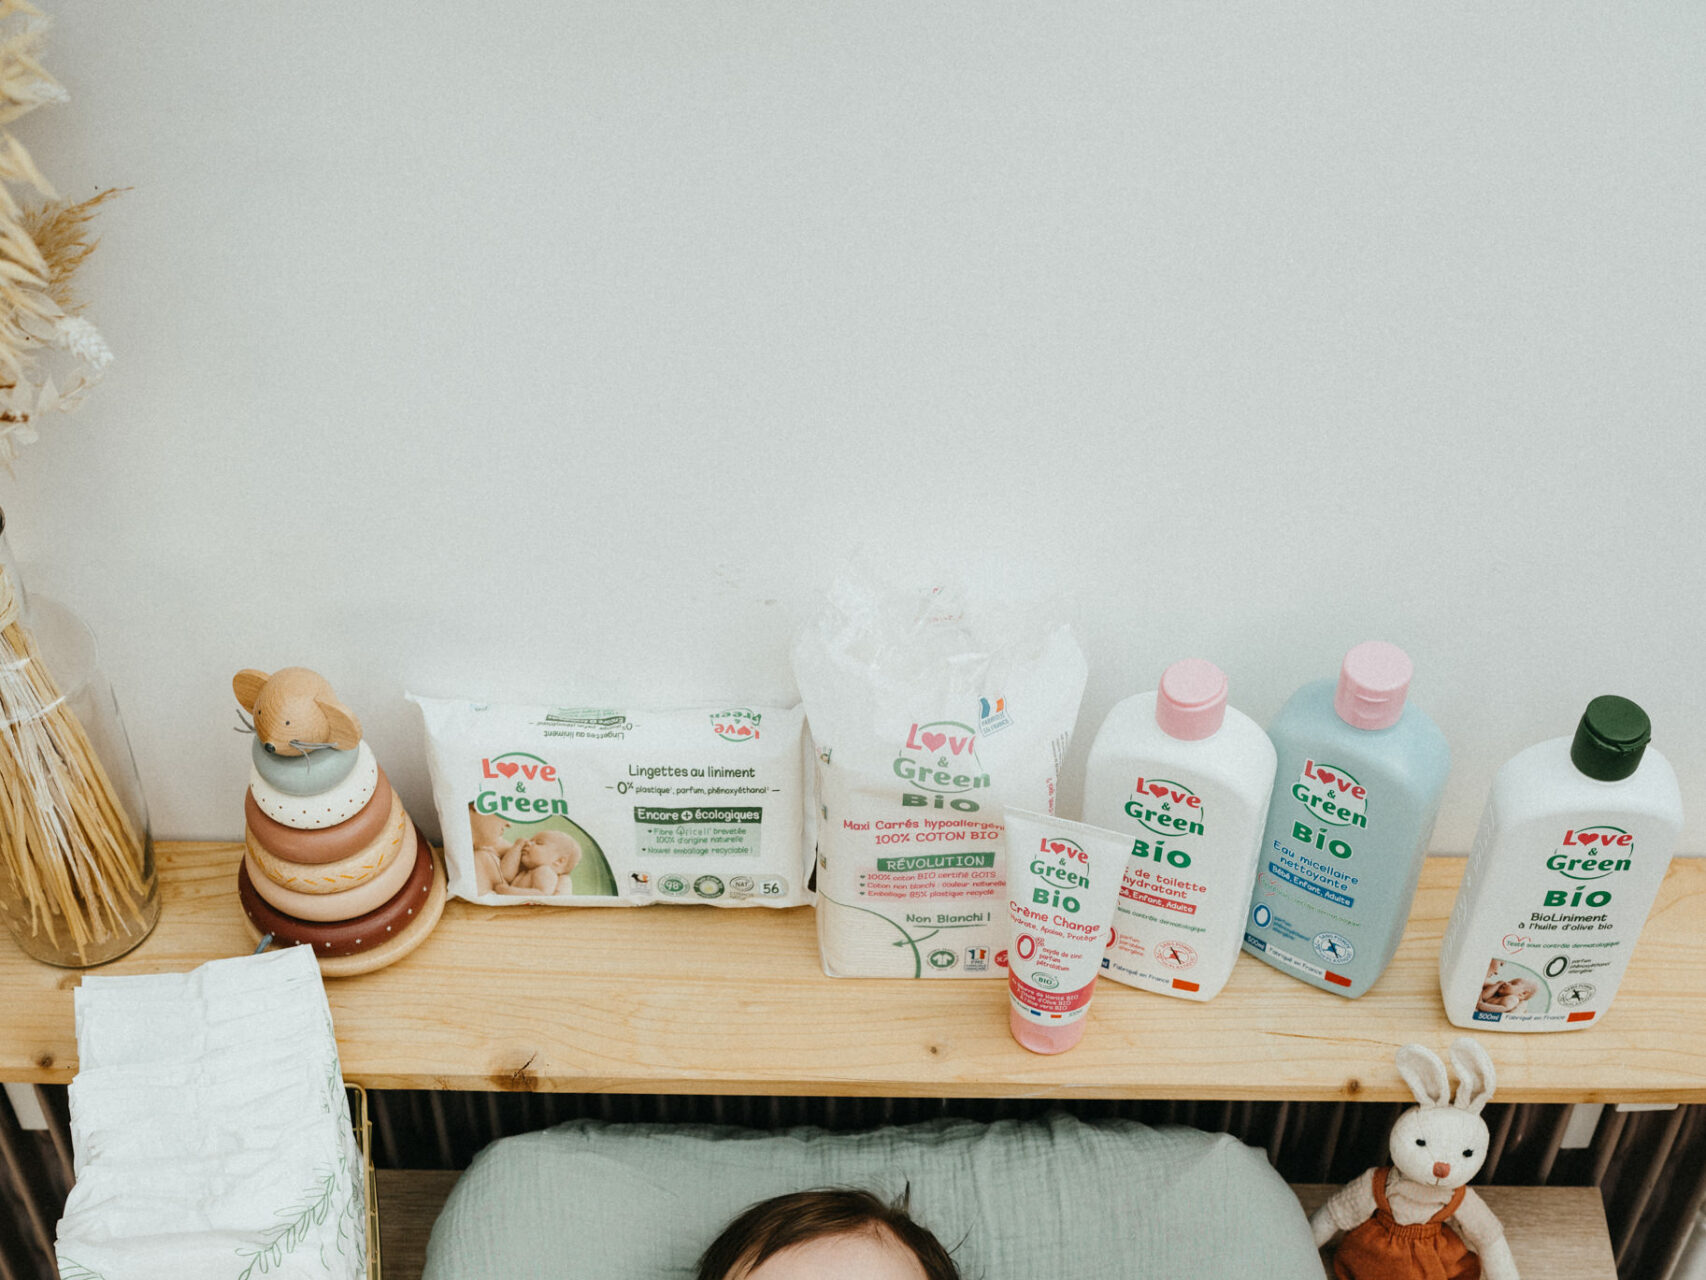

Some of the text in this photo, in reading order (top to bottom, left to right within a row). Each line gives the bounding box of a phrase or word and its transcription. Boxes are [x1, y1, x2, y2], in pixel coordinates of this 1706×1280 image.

[937, 756, 949, 768] &
[482, 758, 556, 782] Love
[628, 764, 756, 779] Lingettes au liniment
[893, 757, 991, 788] Green
[515, 781, 526, 793] &
[1304, 760, 1366, 800] Love
[1136, 777, 1201, 808] Love
[1327, 790, 1336, 799] &
[475, 790, 569, 814] Green
[1161, 802, 1171, 811] &
[1292, 784, 1367, 828] Green
[637, 808, 679, 820] Encore
[695, 808, 761, 823] écologiques
[1124, 801, 1204, 836] Green
[843, 819, 870, 831] Maxi
[875, 819, 920, 830] Carrés
[875, 831, 999, 845] 100% COTON BIO
[1563, 830, 1633, 846] Love
[1040, 838, 1088, 864] Love
[1588, 847, 1598, 856] &
[886, 856, 986, 871] RÉVOLUTION
[1059, 858, 1066, 866] &
[1273, 840, 1358, 885] Eau micellaire
[1546, 854, 1632, 871] Green
[867, 873, 891, 881] 100%
[917, 871, 936, 880] BIO
[1029, 860, 1090, 889] Green
[1135, 869, 1150, 879] de
[1156, 874, 1207, 893] toilette
[1280, 857, 1348, 891] nettoyante
[763, 883, 780, 894] 56
[1122, 874, 1188, 899] hydratant
[1324, 891, 1351, 906] Adulte
[1166, 901, 1193, 913] Adulte
[906, 913, 931, 923] Non
[937, 912, 983, 923] Blanchi
[1009, 901, 1101, 935] Crème Change
[1531, 912, 1608, 922] BioLiniment
